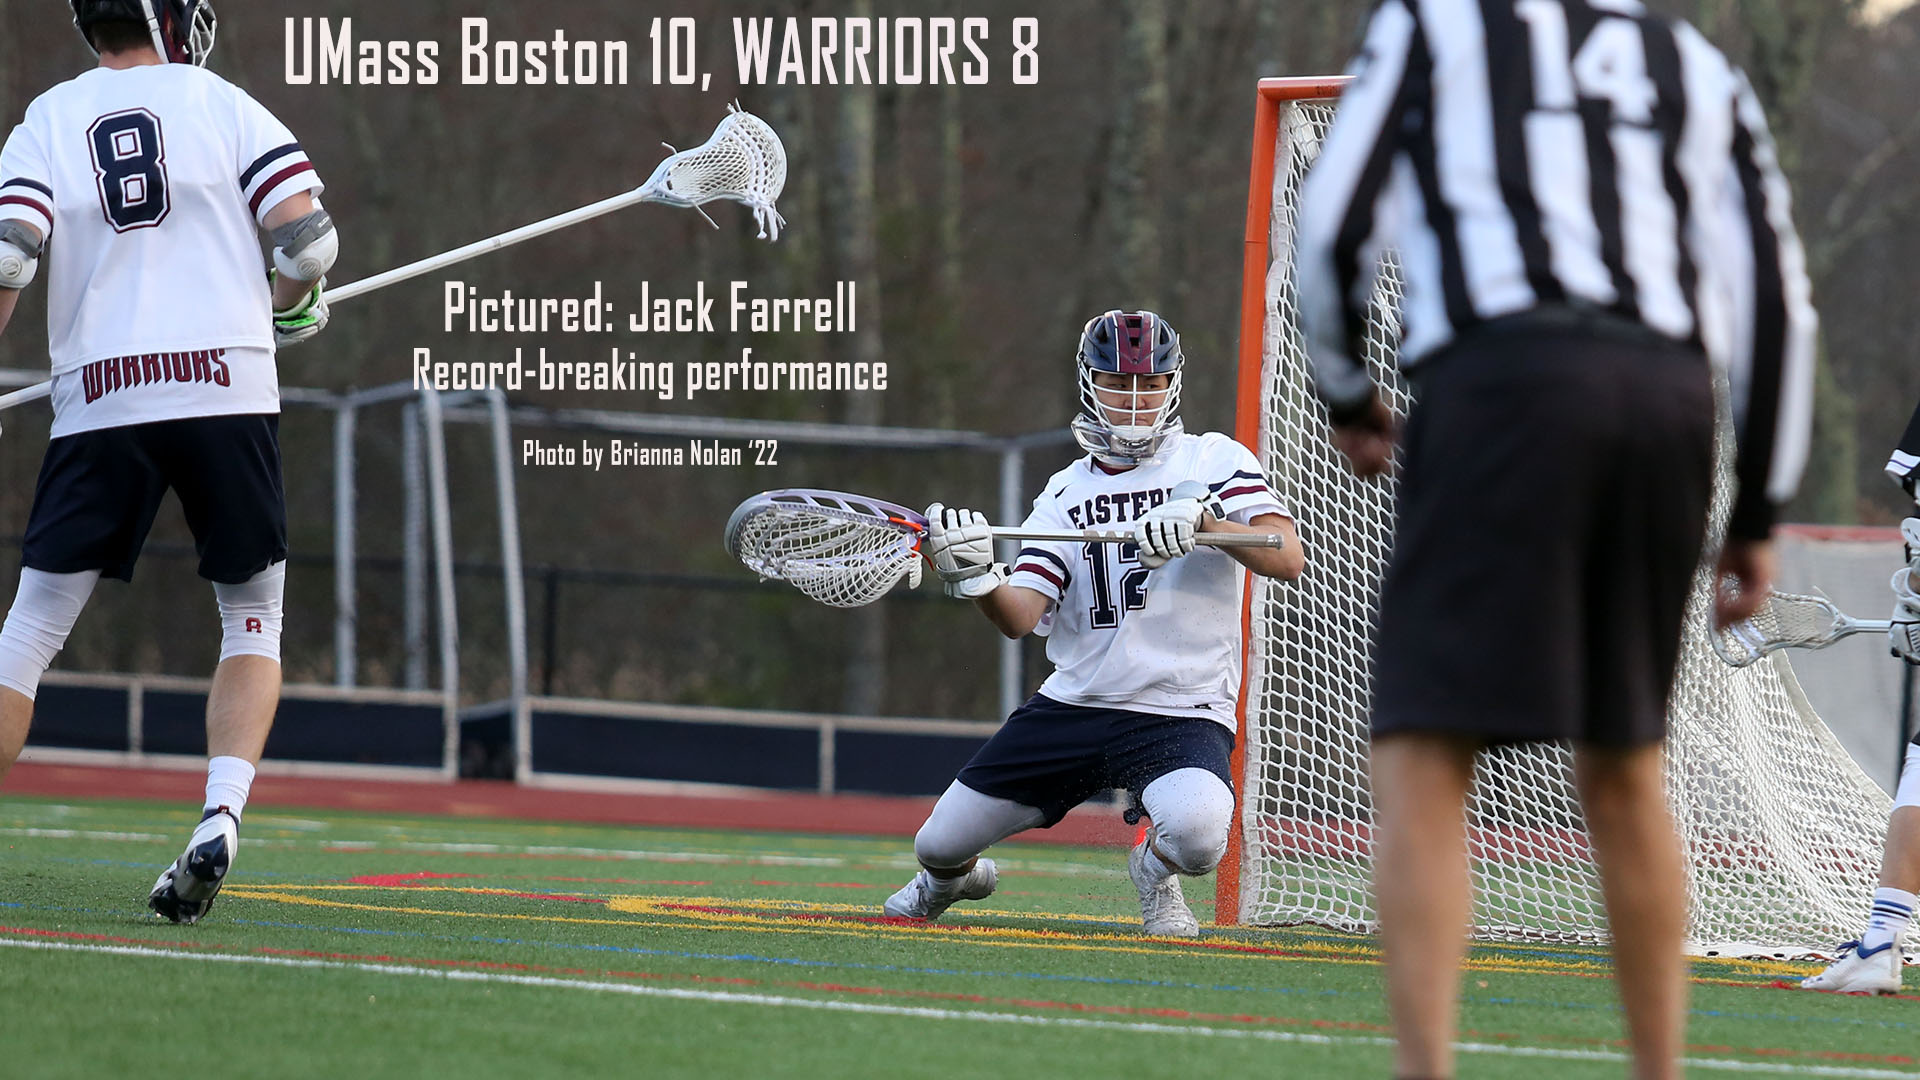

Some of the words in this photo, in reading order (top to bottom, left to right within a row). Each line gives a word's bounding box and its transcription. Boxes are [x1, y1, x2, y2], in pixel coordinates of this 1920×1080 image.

[1514, 0, 1660, 122] 14
[86, 106, 171, 234] 8
[82, 348, 231, 405] WARRIORS
[1082, 540, 1150, 630] 12
